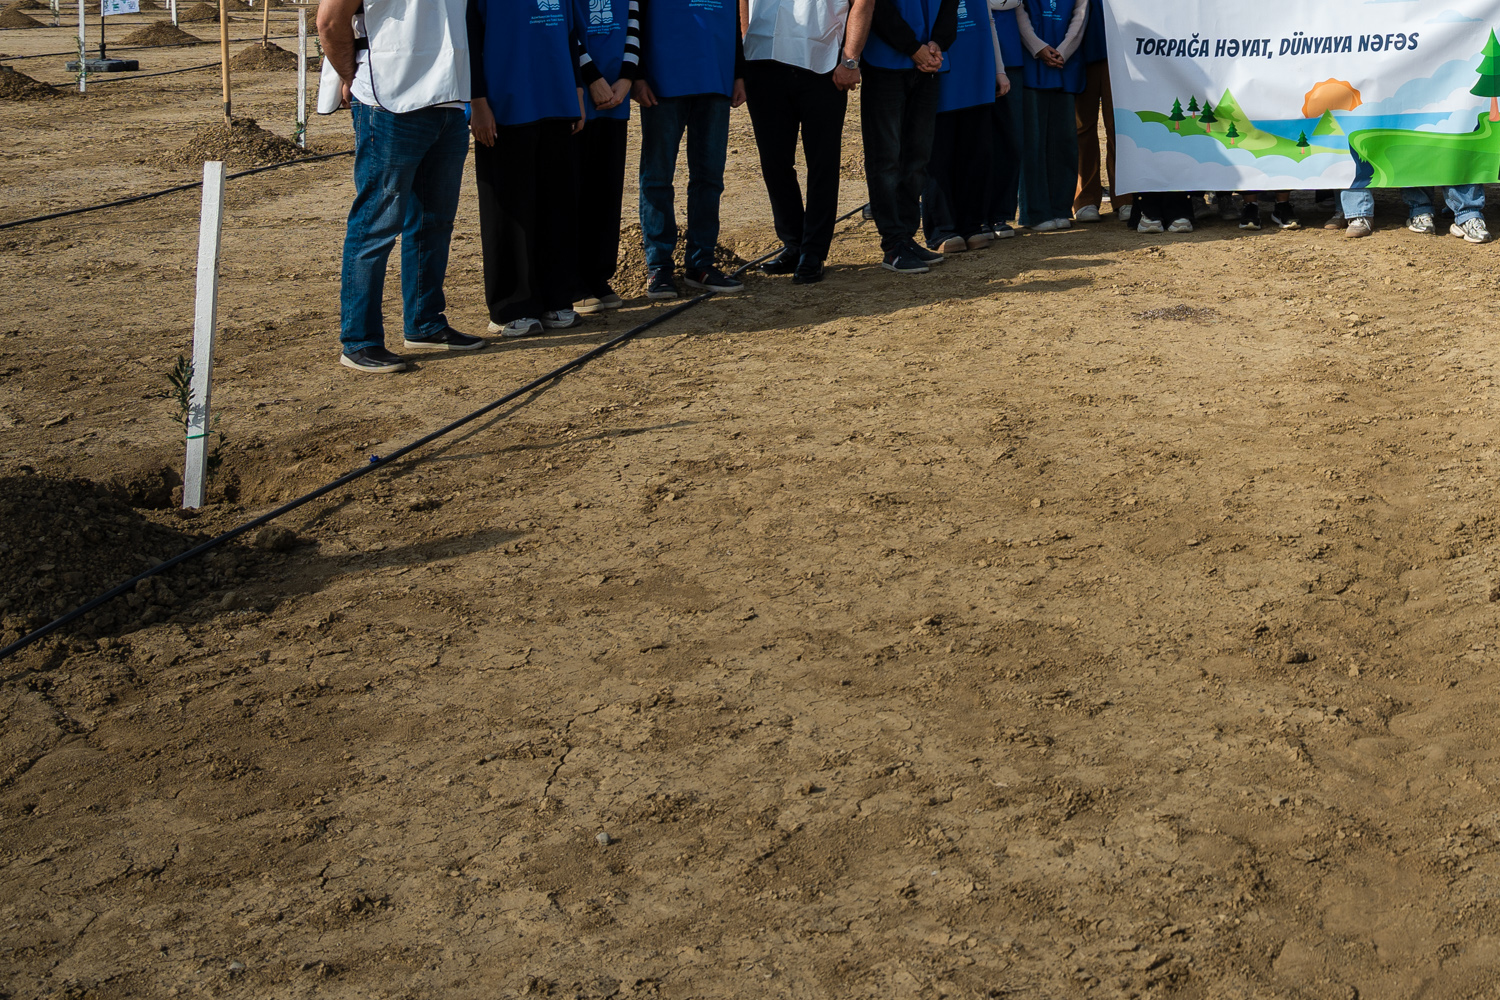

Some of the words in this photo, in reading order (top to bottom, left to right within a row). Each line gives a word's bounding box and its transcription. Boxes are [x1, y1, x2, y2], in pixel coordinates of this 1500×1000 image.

[1135, 33, 1210, 58] TORPAĞA
[1214, 38, 1273, 60] HƏYAT,
[1279, 31, 1353, 56] DÜNYAYA
[1358, 32, 1420, 53] NƏFƏS
